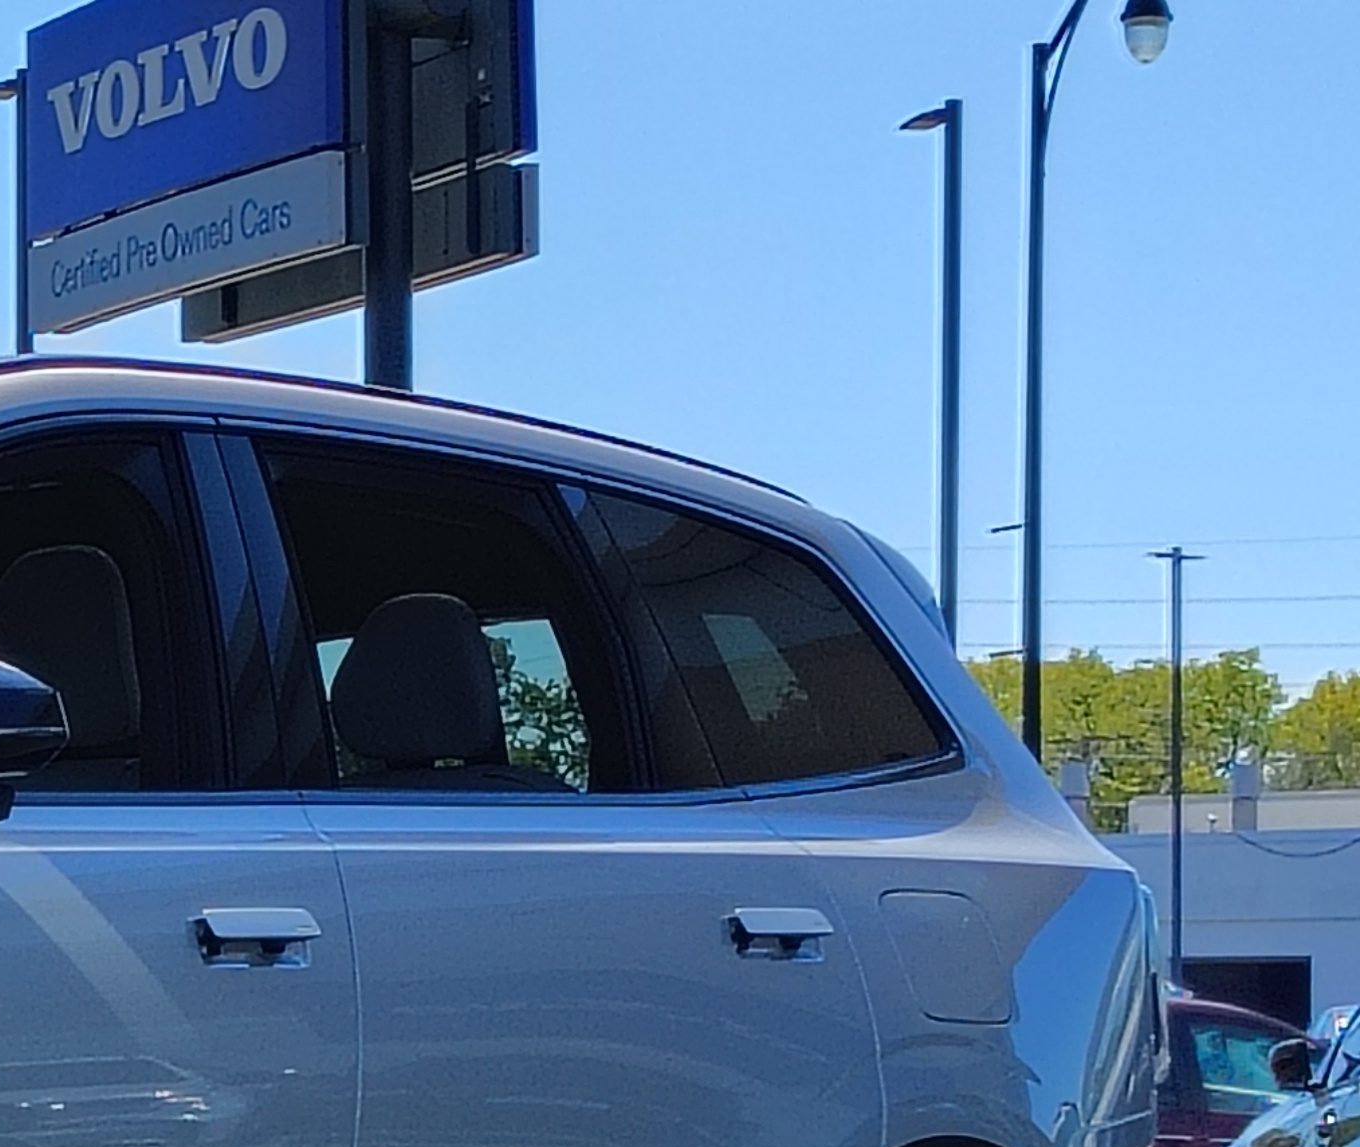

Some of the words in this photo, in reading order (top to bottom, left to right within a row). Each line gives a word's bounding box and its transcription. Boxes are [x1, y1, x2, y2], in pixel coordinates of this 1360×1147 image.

[47, 7, 287, 154] VOLVO
[51, 243, 120, 297] Certified
[127, 236, 157, 272] Pre
[161, 207, 232, 262] Owned
[241, 199, 291, 239] Cars
